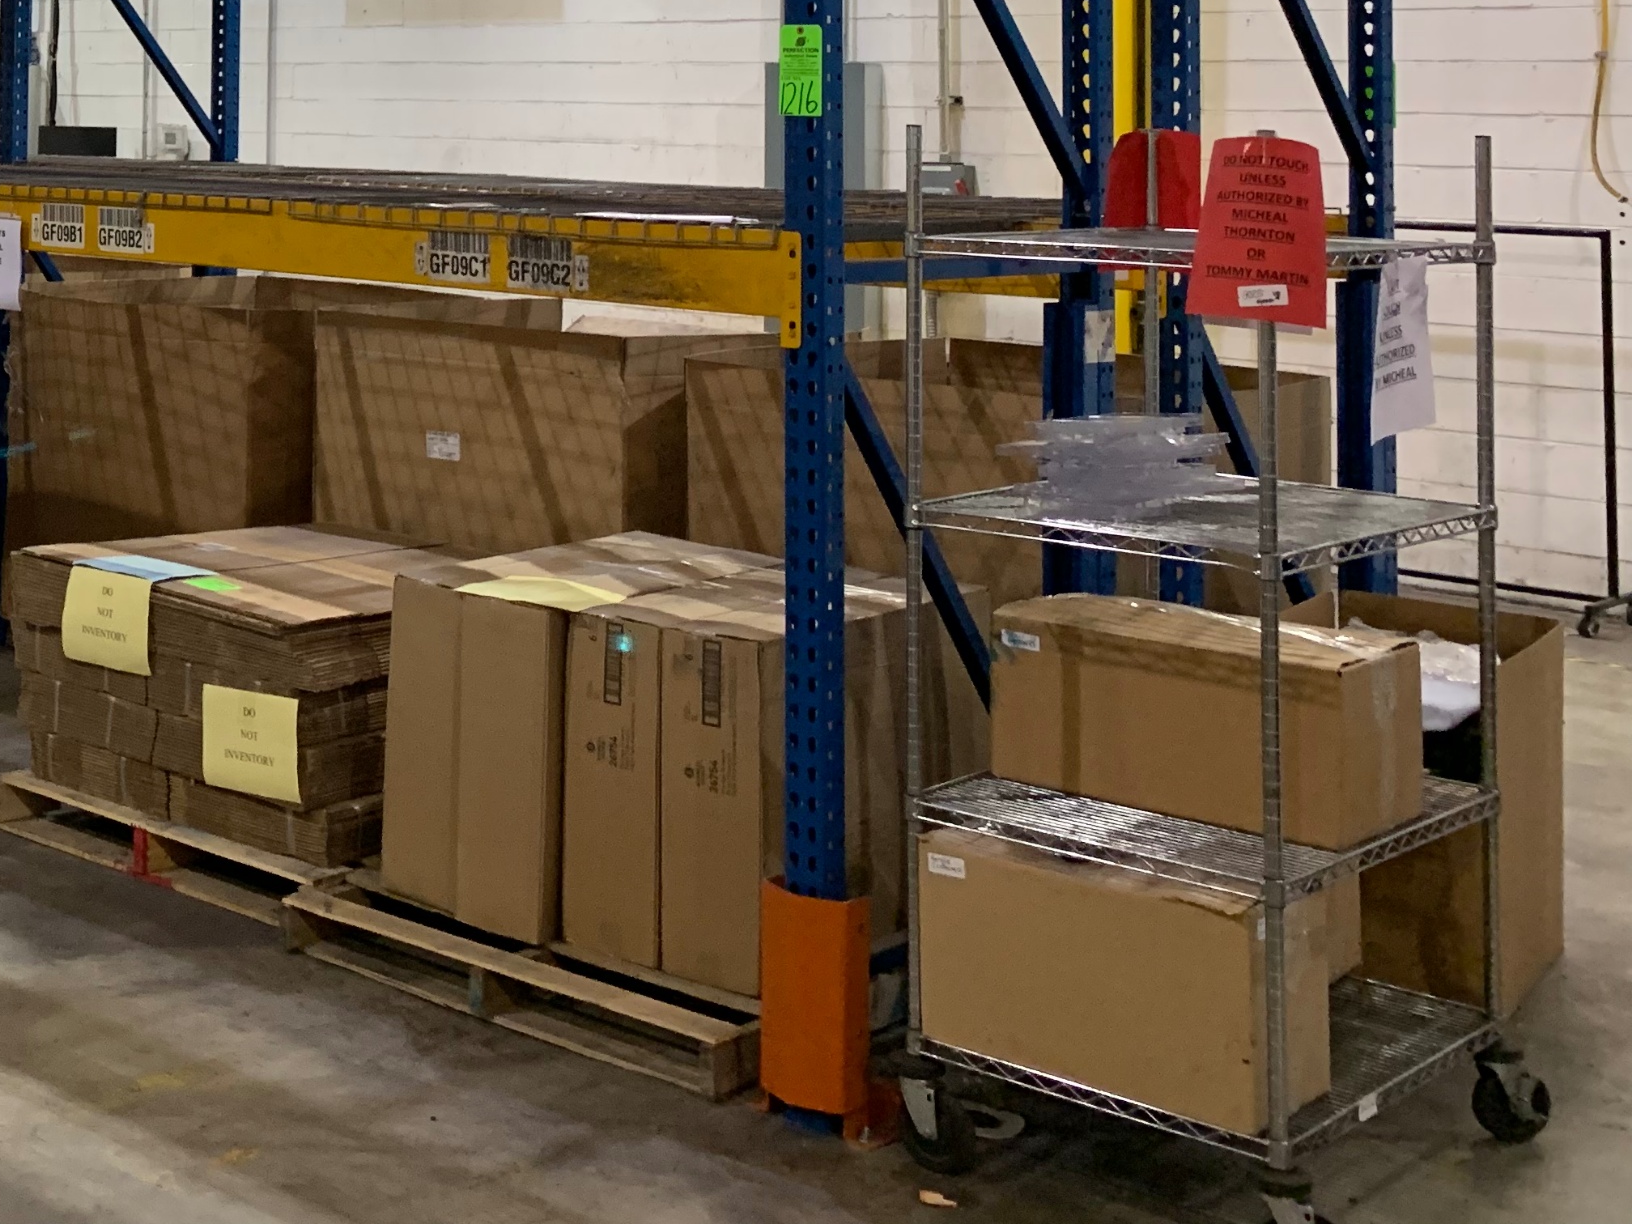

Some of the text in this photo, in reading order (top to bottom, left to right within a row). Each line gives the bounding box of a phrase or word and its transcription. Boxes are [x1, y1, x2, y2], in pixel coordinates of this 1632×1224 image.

[780, 81, 818, 115] 1216
[1223, 155, 1309, 171] DO NOT TOUCH
[1239, 173, 1286, 186] UNLESS
[1218, 190, 1309, 208] AUTHORIZED BY
[1232, 208, 1288, 223] MICHEAL
[42, 223, 143, 249] GF09B1 GF09B2
[1224, 226, 1295, 242] THORNTON
[1247, 248, 1265, 259] OR
[429, 253, 572, 287] GF09C1 GF09C2
[1206, 264, 1309, 285] TOMMY MARTIN
[1382, 366, 1417, 385] MICHEAL
[102, 585, 113, 596] DO
[97, 607, 114, 619] NOT
[81, 625, 127, 643] INVENTORY
[242, 706, 256, 718] DO
[240, 729, 258, 742] NOT
[224, 748, 275, 768] INVENTORY
